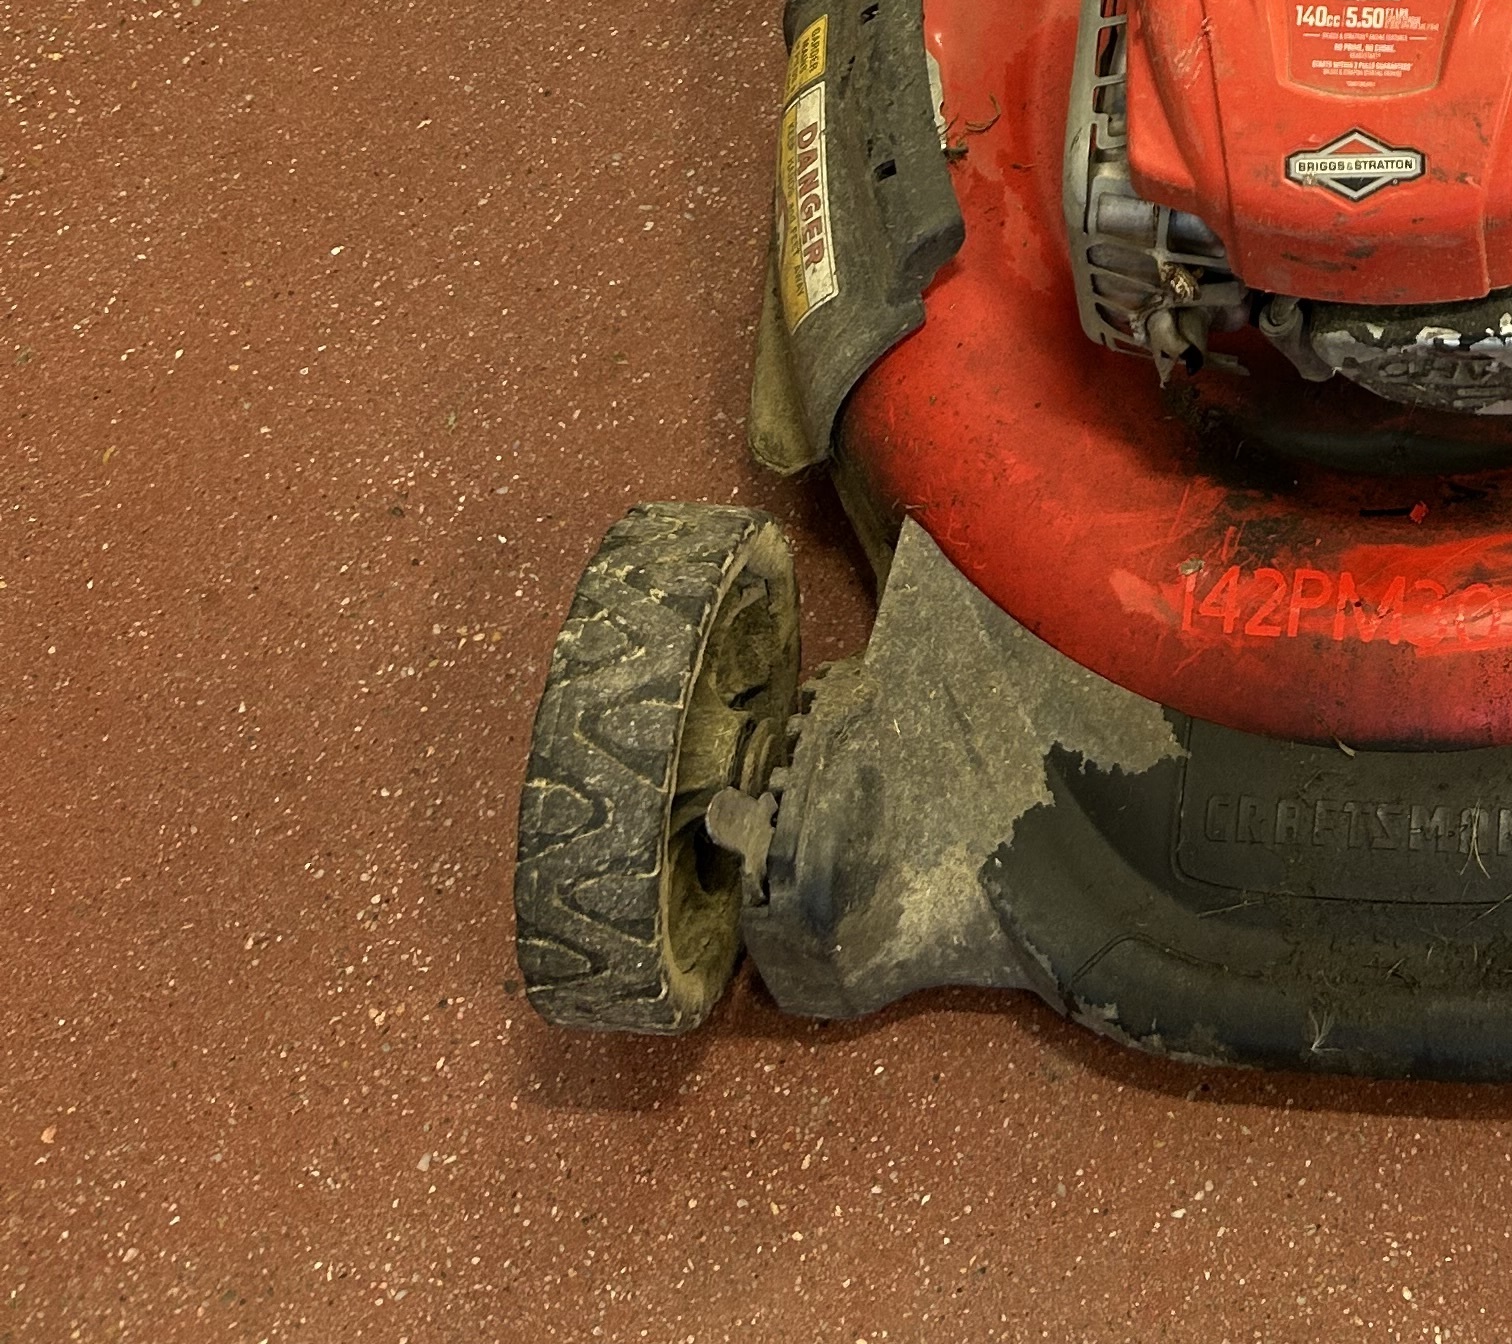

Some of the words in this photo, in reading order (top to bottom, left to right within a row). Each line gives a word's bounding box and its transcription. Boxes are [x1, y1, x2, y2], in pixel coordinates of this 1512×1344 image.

[1345, 6, 1385, 29] 5.50
[797, 121, 825, 271] DANGER
[790, 227, 801, 257] FEET
[793, 263, 805, 298] AWAY
